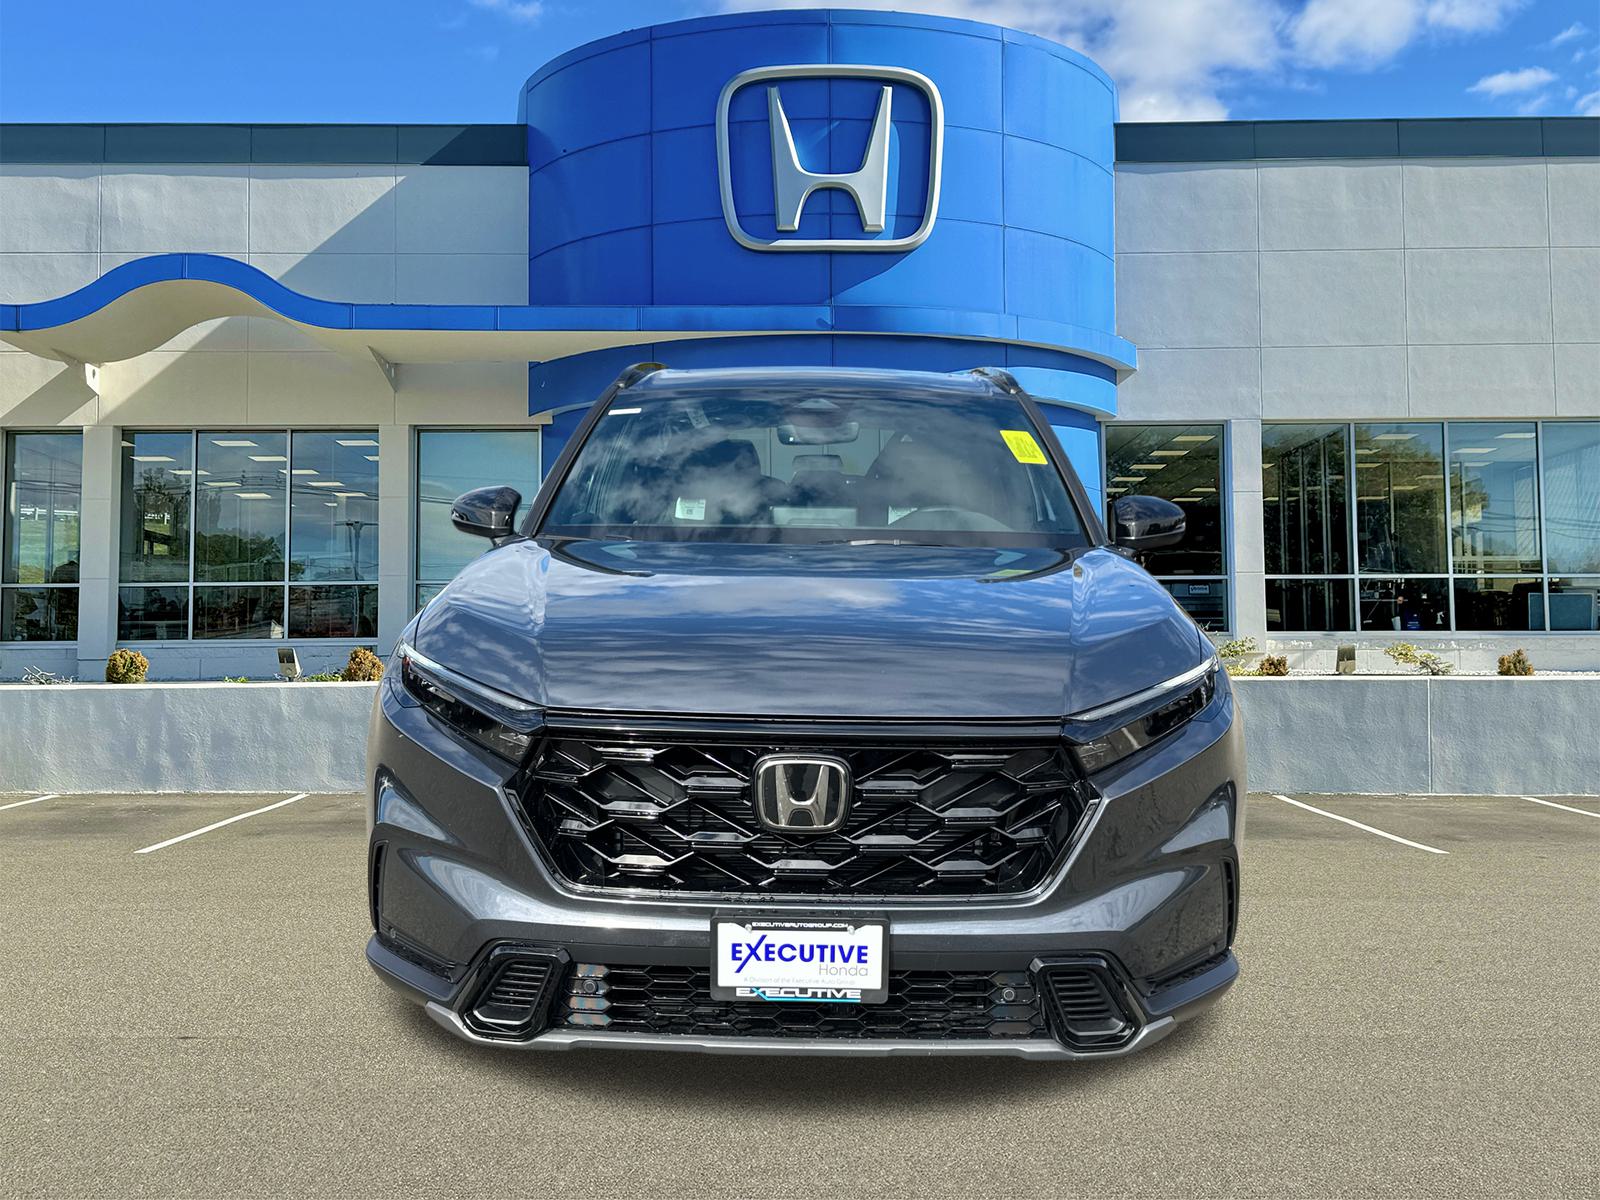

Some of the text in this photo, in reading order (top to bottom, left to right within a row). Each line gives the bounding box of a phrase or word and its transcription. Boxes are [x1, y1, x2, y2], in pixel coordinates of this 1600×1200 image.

[731, 934, 868, 973] EXECUTIVE
[819, 964, 868, 977] Honda
[736, 987, 861, 1000] EXECUTIVE
